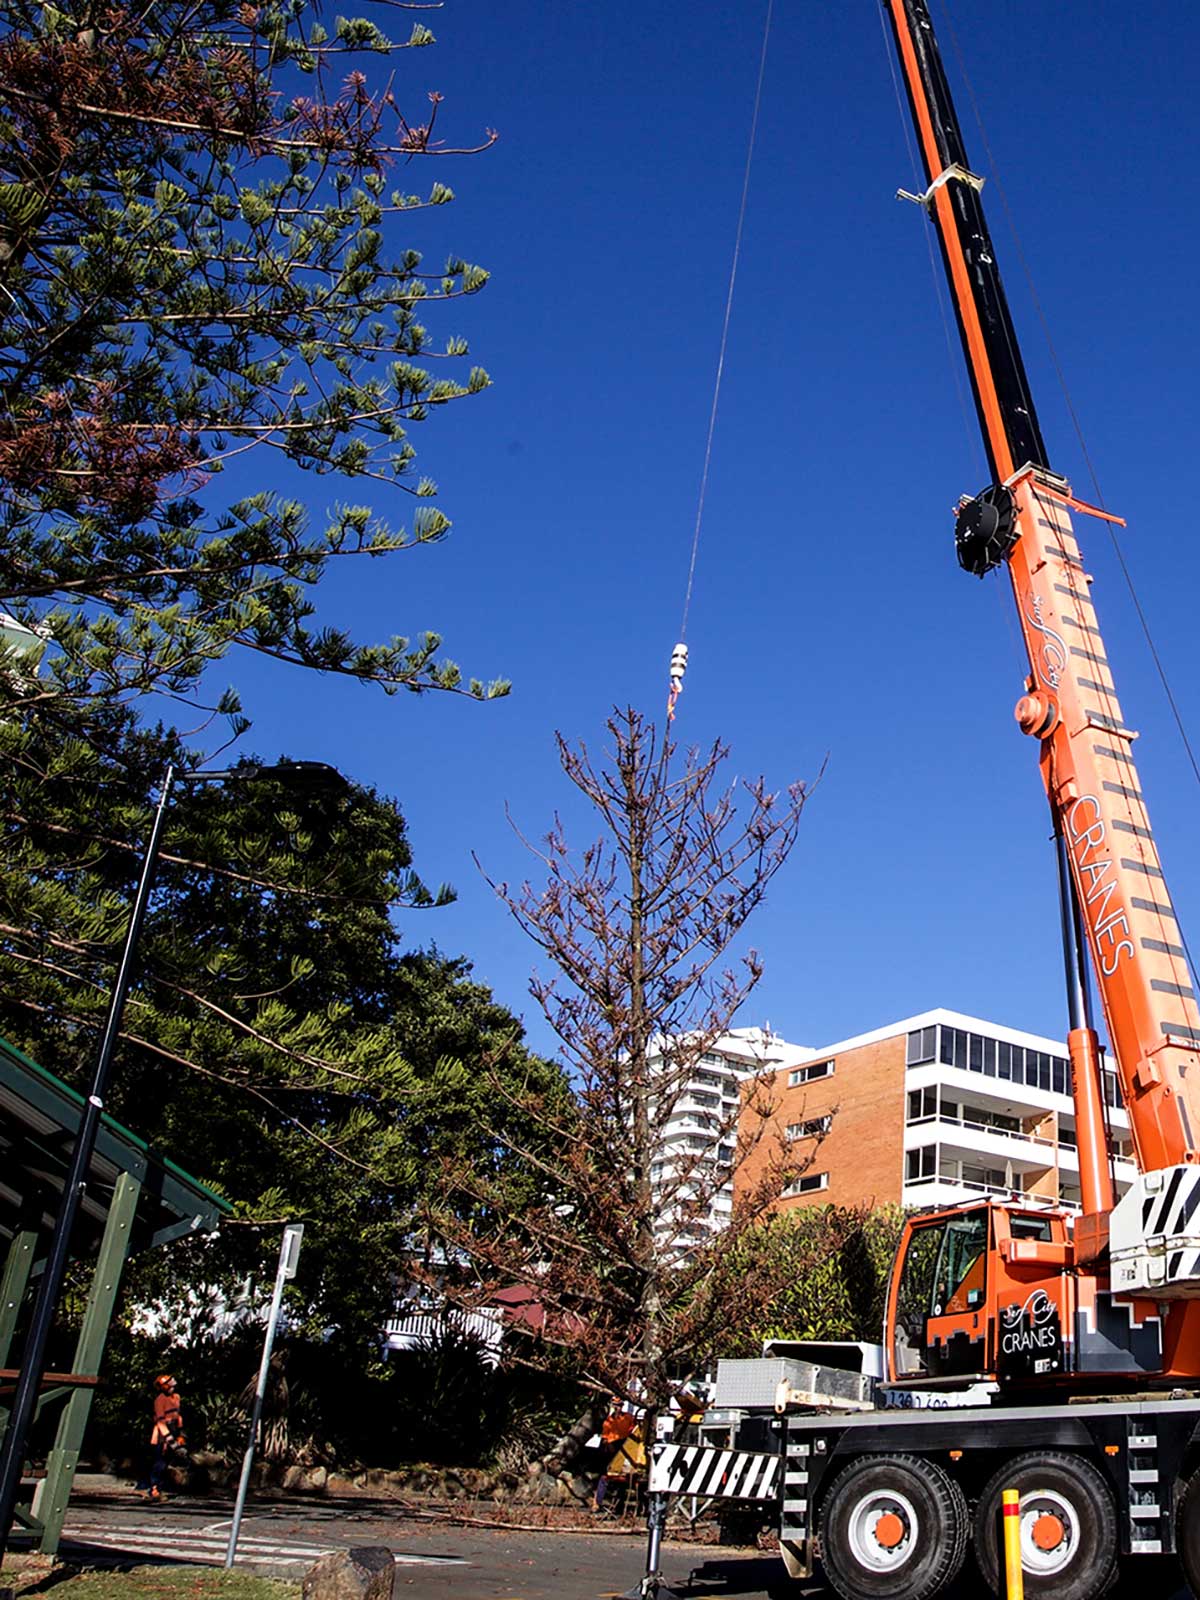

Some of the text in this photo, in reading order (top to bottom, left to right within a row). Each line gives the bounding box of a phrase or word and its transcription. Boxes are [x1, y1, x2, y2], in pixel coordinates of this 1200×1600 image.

[1069, 795, 1134, 976] CRANES
[1032, 1294, 1057, 1324] City
[1003, 1326, 1056, 1354] CRANES
